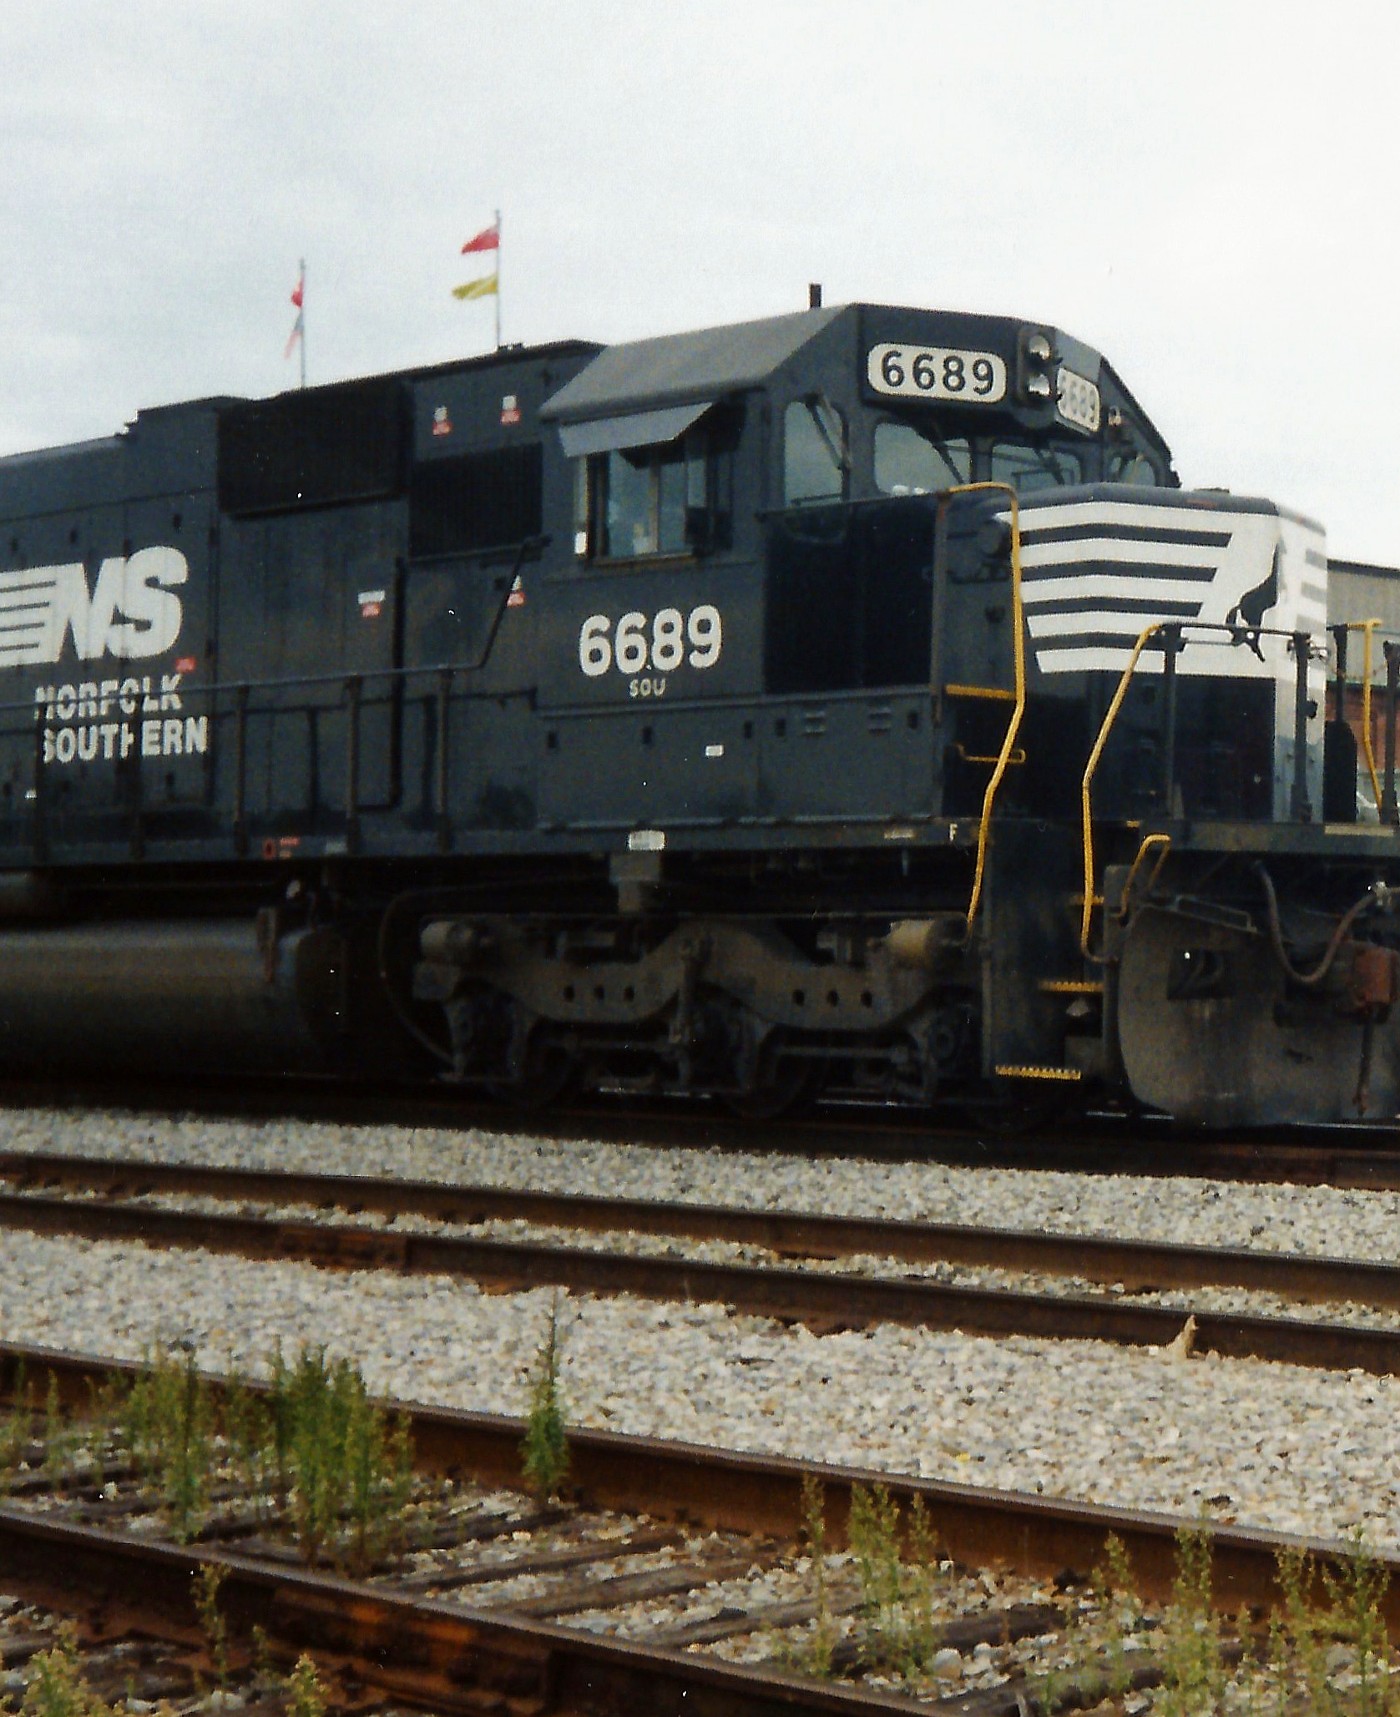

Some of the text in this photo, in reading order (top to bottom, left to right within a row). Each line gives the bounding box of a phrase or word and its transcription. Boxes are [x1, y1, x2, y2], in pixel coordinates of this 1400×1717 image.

[881, 350, 994, 395] 6689
[579, 604, 722, 677] 6689
[34, 673, 183, 721] NORFOLK
[629, 677, 667, 698] SOU
